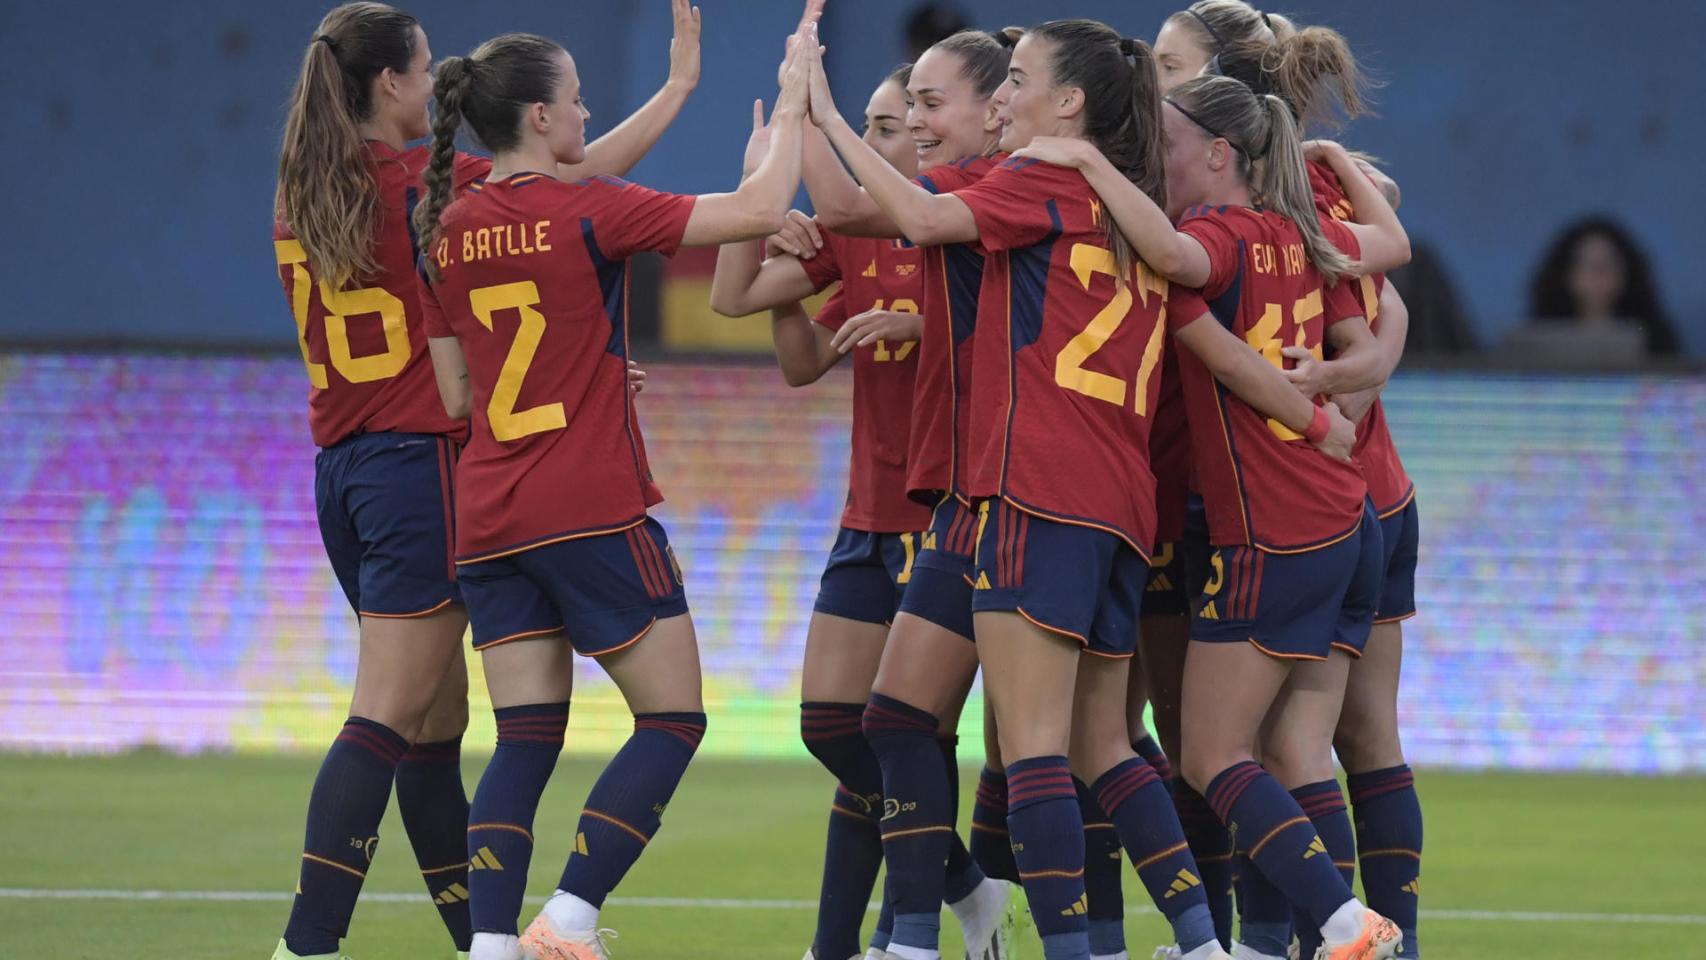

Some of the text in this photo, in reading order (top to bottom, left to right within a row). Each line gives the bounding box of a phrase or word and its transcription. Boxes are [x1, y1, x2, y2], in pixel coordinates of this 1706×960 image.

[462, 220, 552, 262] BATLLE
[469, 280, 567, 442] 2
[1055, 242, 1169, 417] 27
